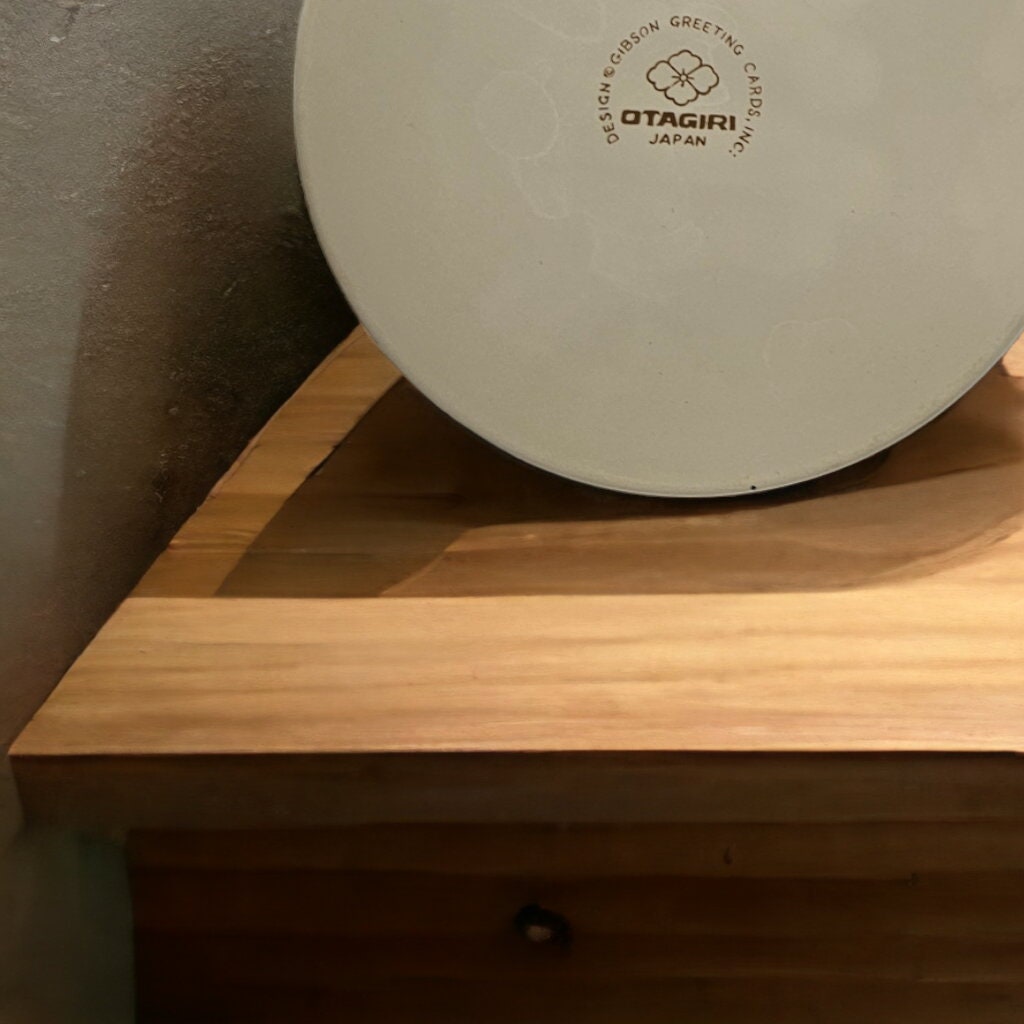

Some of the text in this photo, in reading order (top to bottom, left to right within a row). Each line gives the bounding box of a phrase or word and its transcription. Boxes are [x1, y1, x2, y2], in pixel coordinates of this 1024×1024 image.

[598, 82, 619, 144] DESIGN
[610, 20, 660, 65] GIBSON
[670, 15, 744, 56] GREETING
[620, 109, 736, 131] OTAGIRI
[649, 133, 706, 147] JAPAN
